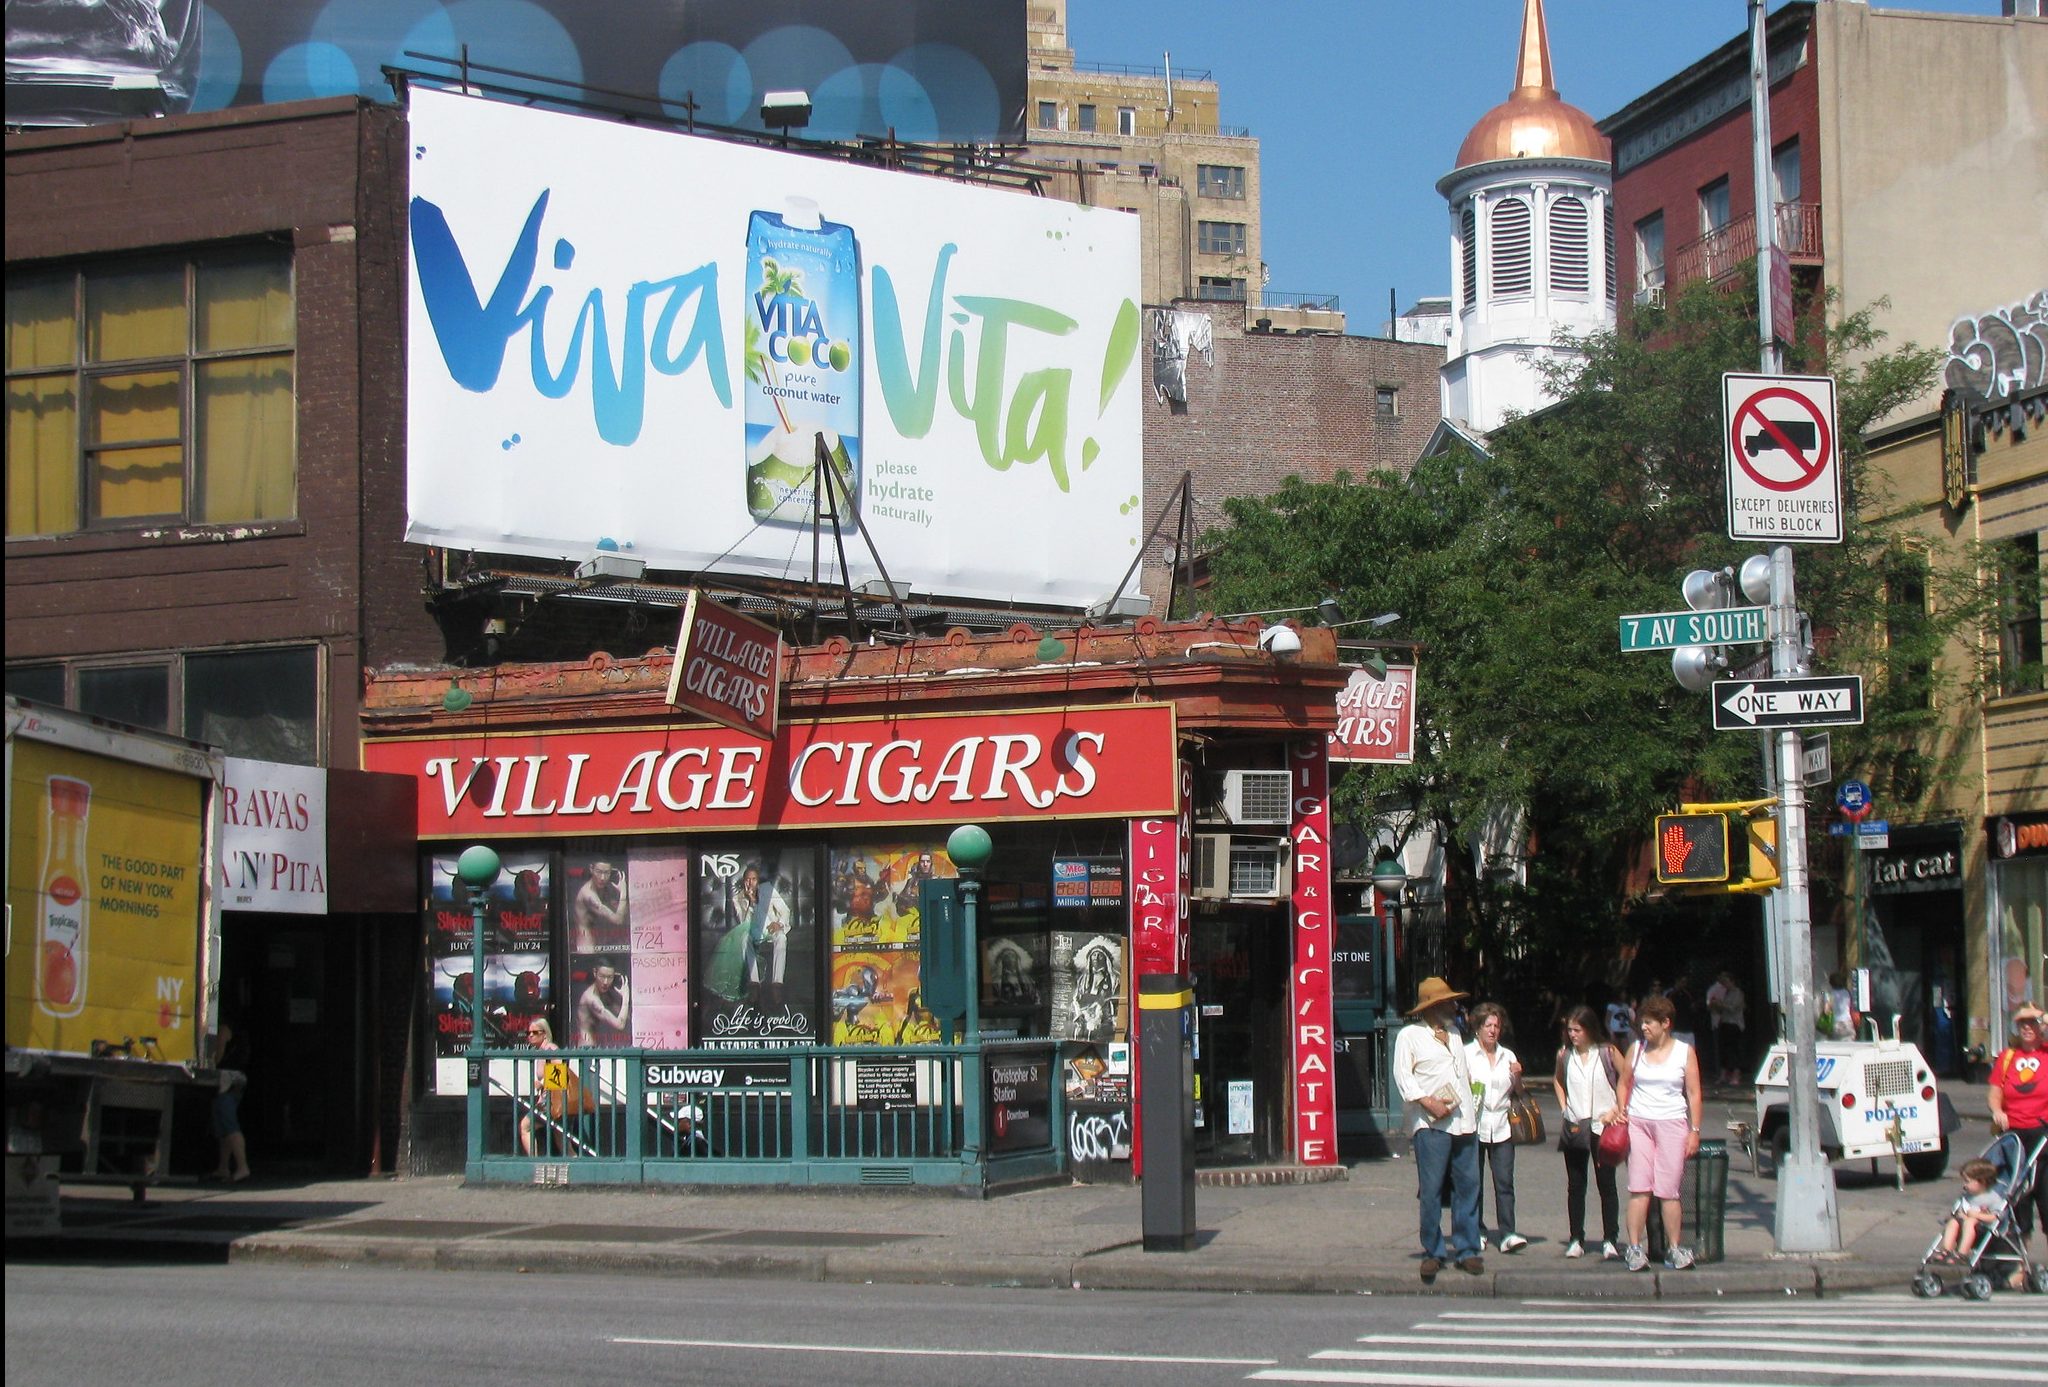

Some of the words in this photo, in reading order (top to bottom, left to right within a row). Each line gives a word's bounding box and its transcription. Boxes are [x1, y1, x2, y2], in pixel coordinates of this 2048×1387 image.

[768, 239, 800, 250] hydrate
[800, 244, 833, 258] naturally
[410, 188, 733, 446] Viva
[754, 290, 827, 338] VITA
[769, 330, 850, 373] COCO
[785, 371, 817, 386] pure
[762, 384, 809, 401] coconut
[810, 392, 841, 406] water
[876, 460, 918, 478] please
[803, 488, 818, 498] fro
[868, 478, 934, 502] hydrate
[872, 504, 933, 529] naturally
[1734, 498, 1771, 513] EXCEPT
[1777, 499, 1835, 515] DELIVERIES
[1747, 516, 1776, 531] THIS
[1781, 517, 1823, 533] BLOCK
[1627, 621, 1640, 647] 7
[1650, 618, 1677, 646] AV
[1688, 612, 1760, 644] SOUTH
[696, 618, 775, 678] VILLAGE
[686, 656, 770, 722] CIGARS
[1737, 694, 1778, 714] ONE
[1797, 691, 1841, 712] WAY
[1808, 751, 1825, 771] WAY
[425, 746, 763, 818] VILLAGE
[790, 731, 1106, 809] CIGARS
[224, 786, 309, 832] RAVAS
[102, 854, 121, 870] THE
[125, 858, 158, 876] GOOD
[160, 865, 186, 881] PART
[271, 853, 325, 893] PITA
[1141, 820, 1165, 931] CIGAR
[1179, 772, 1192, 962] CANDY
[1873, 856, 1908, 884] fat
[1914, 851, 1955, 879] cat
[101, 875, 115, 890] OF
[118, 878, 143, 895] NEW
[145, 882, 174, 899] YORK
[100, 896, 159, 919] MORNINGS
[1056, 898, 1086, 907] Million
[1091, 898, 1121, 907] Million
[450, 942, 469, 952] JULY
[513, 942, 530, 952] JULY
[531, 941, 541, 951] 24
[1350, 952, 1371, 962] ONE
[633, 957, 676, 968] PASSION
[156, 975, 184, 1002] NY
[727, 1004, 754, 1035] life
[752, 1012, 765, 1029] is
[759, 1004, 791, 1036] good
[1183, 1010, 1190, 1035] P
[1334, 1040, 1350, 1053] St
[647, 1066, 725, 1088] Subway
[992, 1067, 1029, 1086] Christopher
[1030, 1066, 1039, 1082] St
[993, 1086, 1017, 1103] Station
[1229, 1084, 1252, 1092] smokes
[998, 1110, 1004, 1129] 1
[1006, 1109, 1030, 1121] Downtown
[1865, 1106, 1919, 1123] POLICE
